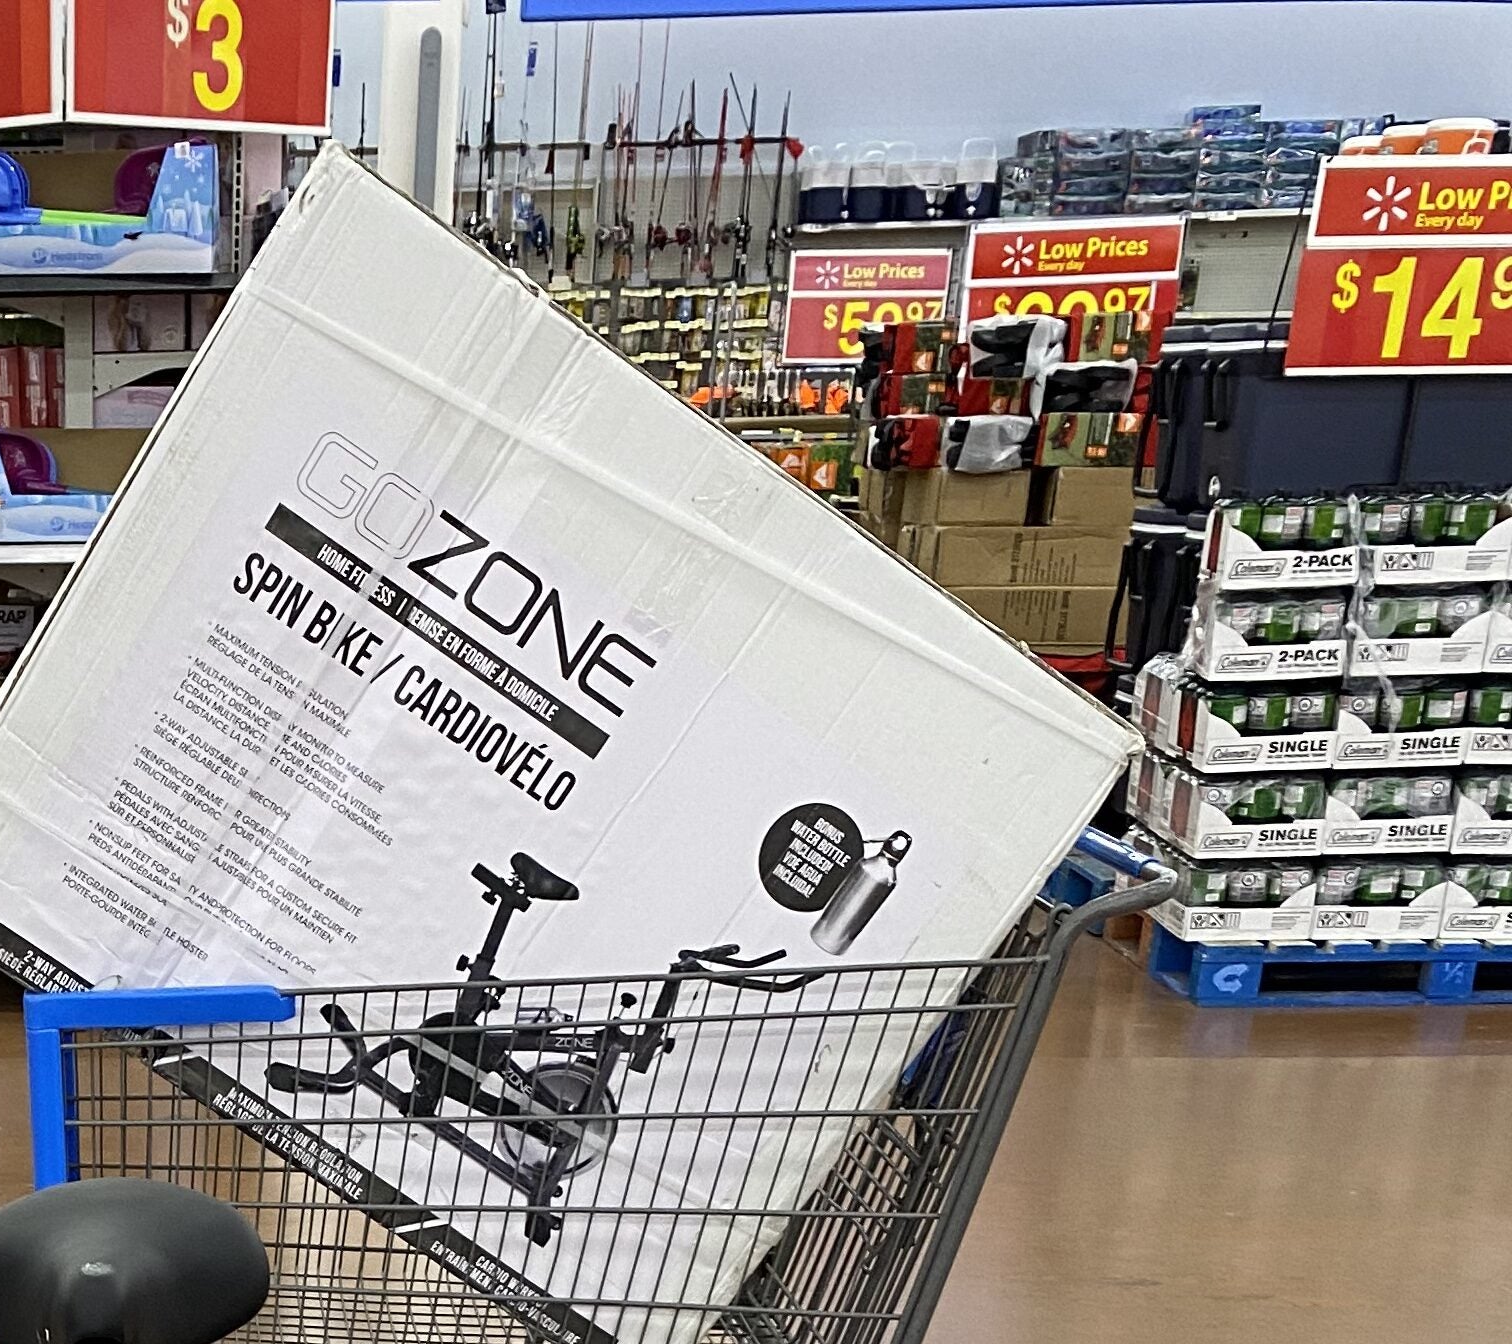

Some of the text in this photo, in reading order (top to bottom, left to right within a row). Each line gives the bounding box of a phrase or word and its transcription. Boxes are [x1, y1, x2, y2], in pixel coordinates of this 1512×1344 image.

[1418, 182, 1484, 210] Low
[1416, 212, 1484, 231] Every day
[1040, 236, 1149, 259] Low Prices
[843, 263, 925, 278] Low Prices
[1038, 260, 1085, 272] Every day
[1293, 554, 1353, 568] 2-PACK
[296, 431, 657, 718] GOZONE
[315, 543, 354, 578] HOME
[346, 565, 398, 608] FITESS
[441, 631, 464, 654] EN
[456, 642, 502, 680] FORME
[502, 674, 560, 721] DOMICILE
[1278, 649, 1338, 662] 2-PACK
[233, 552, 313, 629] SPIN
[302, 600, 384, 678] BIKE
[393, 665, 577, 811] CARDIOVÉLO
[1268, 740, 1328, 753] SINGLE
[1400, 736, 1461, 750] SINGLE
[813, 818, 845, 844] BONUS
[1259, 829, 1317, 842] SINGLE
[1388, 825, 1448, 837] SINGLE
[790, 820, 851, 868] WATER BOTTLE
[22, 949, 56, 977] 2-WAY
